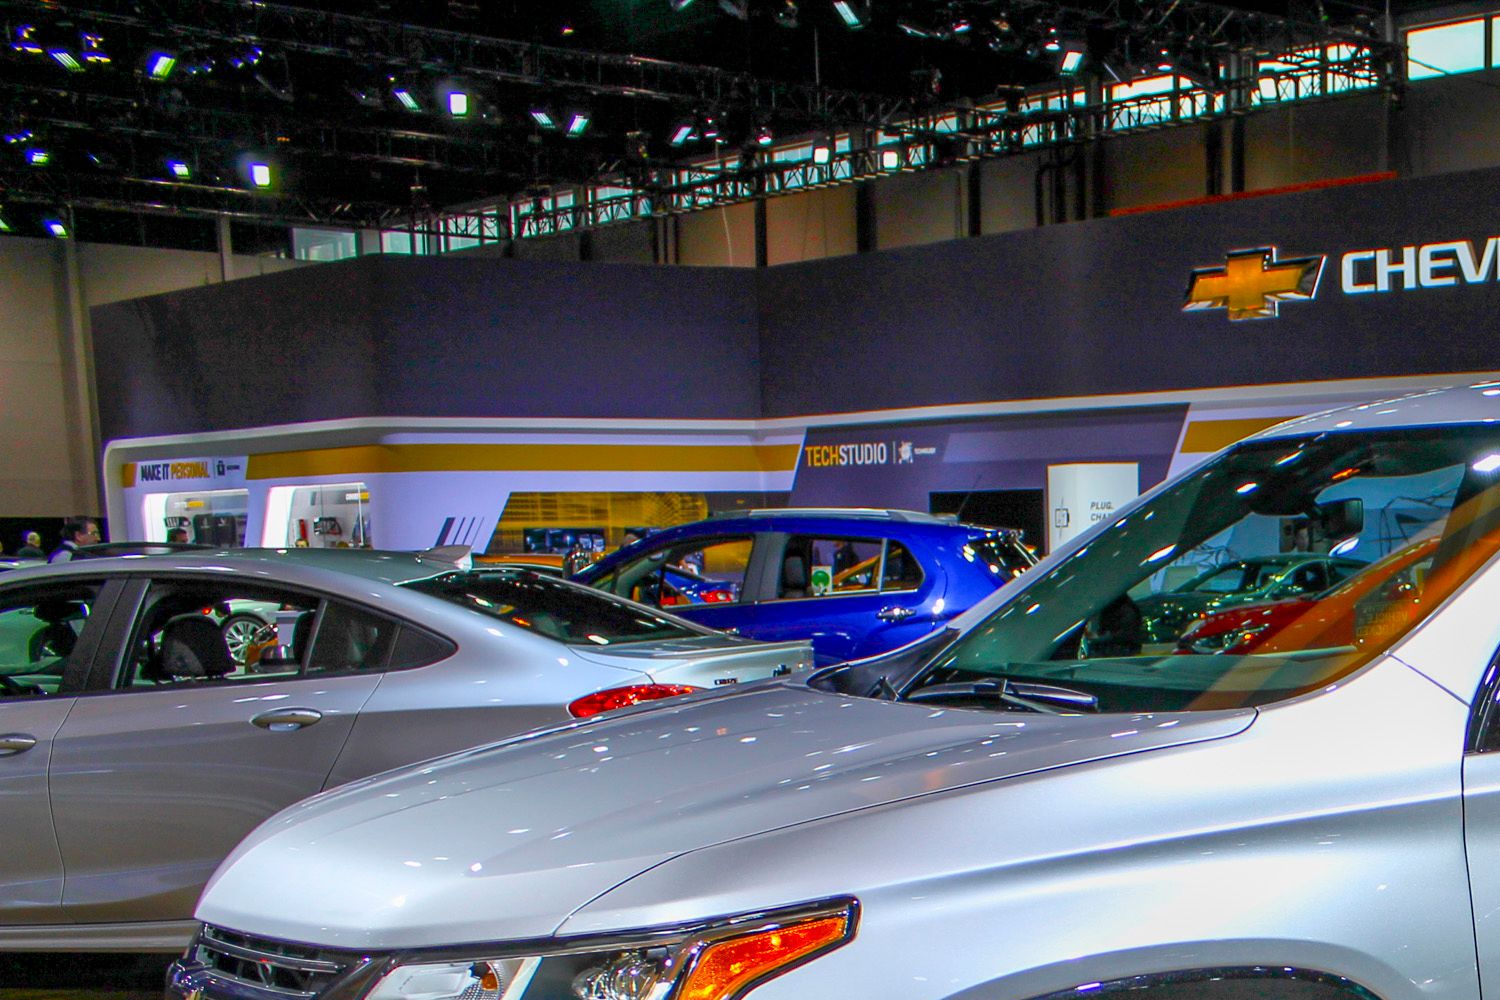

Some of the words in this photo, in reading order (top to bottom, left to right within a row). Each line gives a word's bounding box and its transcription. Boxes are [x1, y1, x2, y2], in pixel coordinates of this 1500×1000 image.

[805, 442, 887, 467] TECHSTUDIO
[140, 463, 161, 481] MAKE
[162, 463, 170, 480] IT
